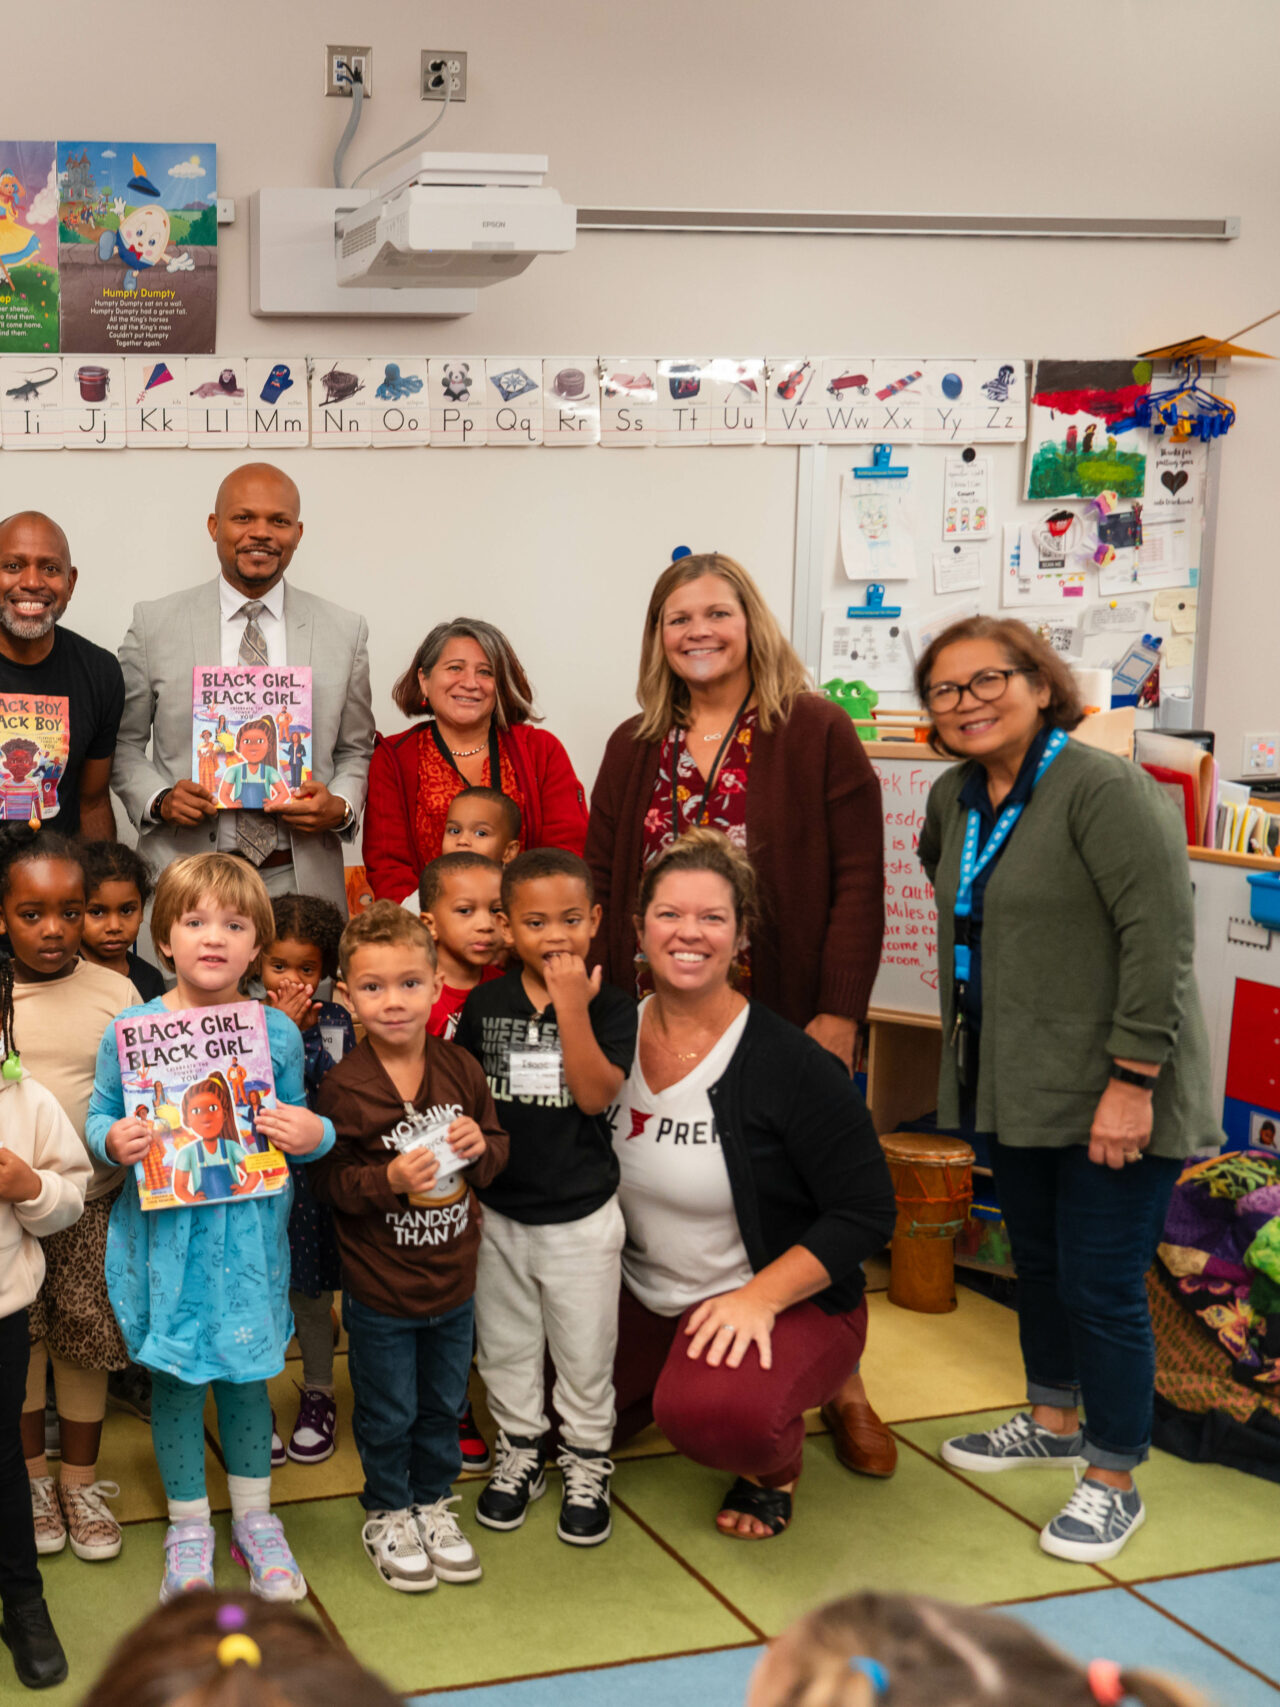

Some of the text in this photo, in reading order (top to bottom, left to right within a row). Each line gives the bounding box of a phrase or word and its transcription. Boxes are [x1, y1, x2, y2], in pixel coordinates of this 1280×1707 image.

[102, 288, 176, 300] Humpty Dumpty
[158, 308, 175, 316] great
[24, 410, 40, 434] Ii
[79, 408, 107, 444] Jj
[141, 408, 174, 431] Kk
[206, 408, 229, 432] Ll
[255, 408, 302, 432] Mm
[325, 408, 360, 432] Nn
[383, 408, 419, 431] Oo
[443, 408, 474, 442] Pp
[495, 407, 536, 441] Qq
[615, 408, 644, 431] Ss
[672, 408, 698, 430] Tt
[723, 407, 753, 429] Uu
[781, 407, 809, 430] Vv
[826, 407, 869, 429] Ww
[883, 407, 912, 429] Xx
[937, 407, 962, 440] Yy
[986, 407, 1014, 429] Zz
[201, 673, 305, 689] BLACK GIRL,
[201, 690, 302, 706] BLACK GIRL
[34, 701, 63, 716] BOY,
[35, 716, 62, 732] BOY
[892, 836, 906, 851] is
[886, 901, 925, 920] Miles
[905, 923, 919, 936] so
[122, 1012, 254, 1048] BLACK GIRL,
[126, 1036, 253, 1071] BLACK GIRL
[181, 1075, 198, 1083] YOU
[393, 1225, 449, 1246] THAN
